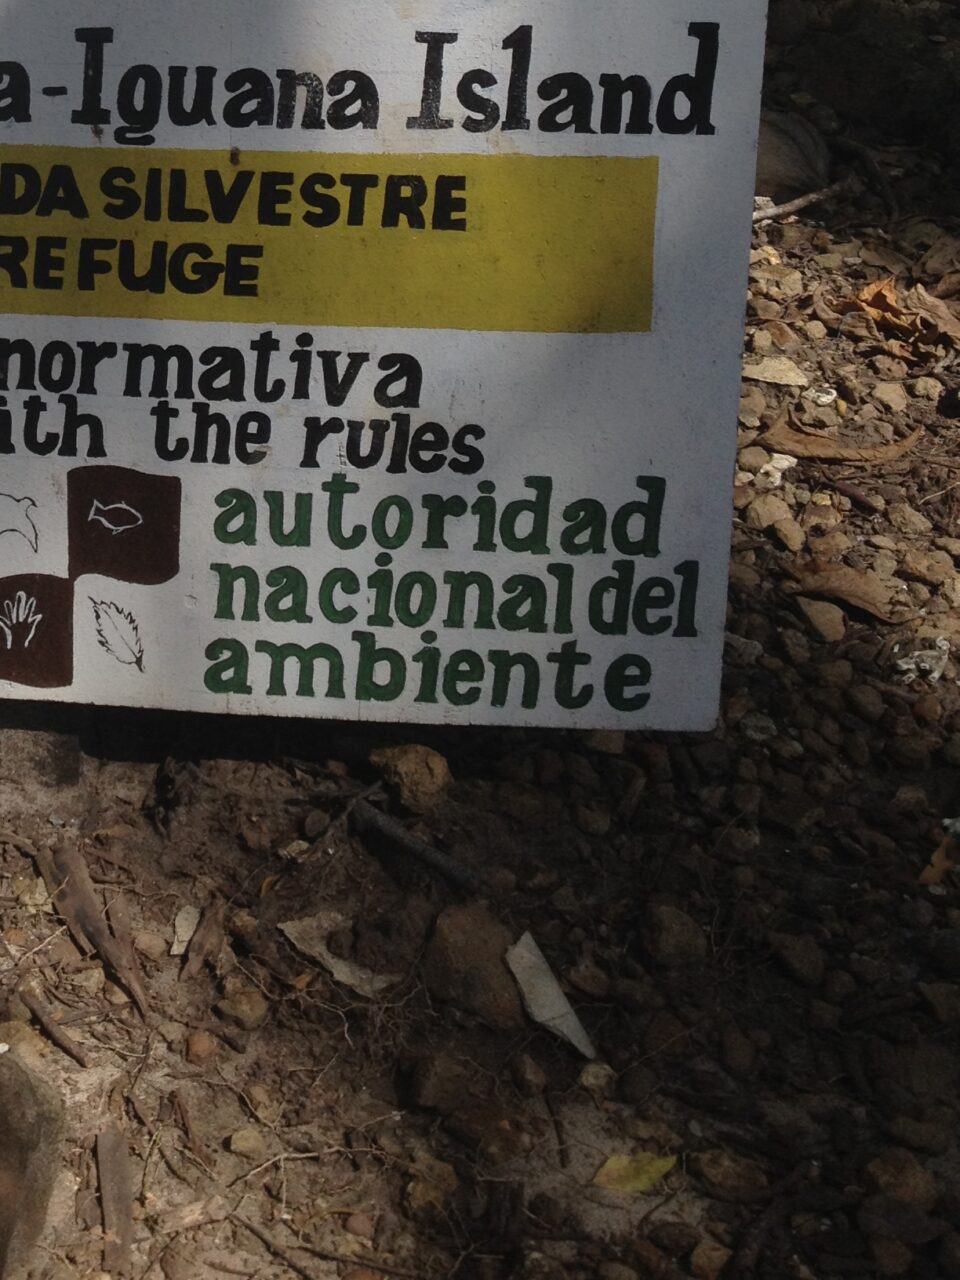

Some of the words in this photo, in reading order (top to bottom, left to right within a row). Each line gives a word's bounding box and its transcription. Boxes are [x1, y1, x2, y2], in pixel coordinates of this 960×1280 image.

[406, 22, 719, 135] Island
[99, 166, 467, 230] SILVESTRE
[151, 399, 271, 464] the
[300, 412, 485, 475] rules
[213, 473, 666, 557] autoridad
[210, 552, 574, 634] nacional
[588, 560, 699, 638] del
[203, 630, 652, 711] ambiente
